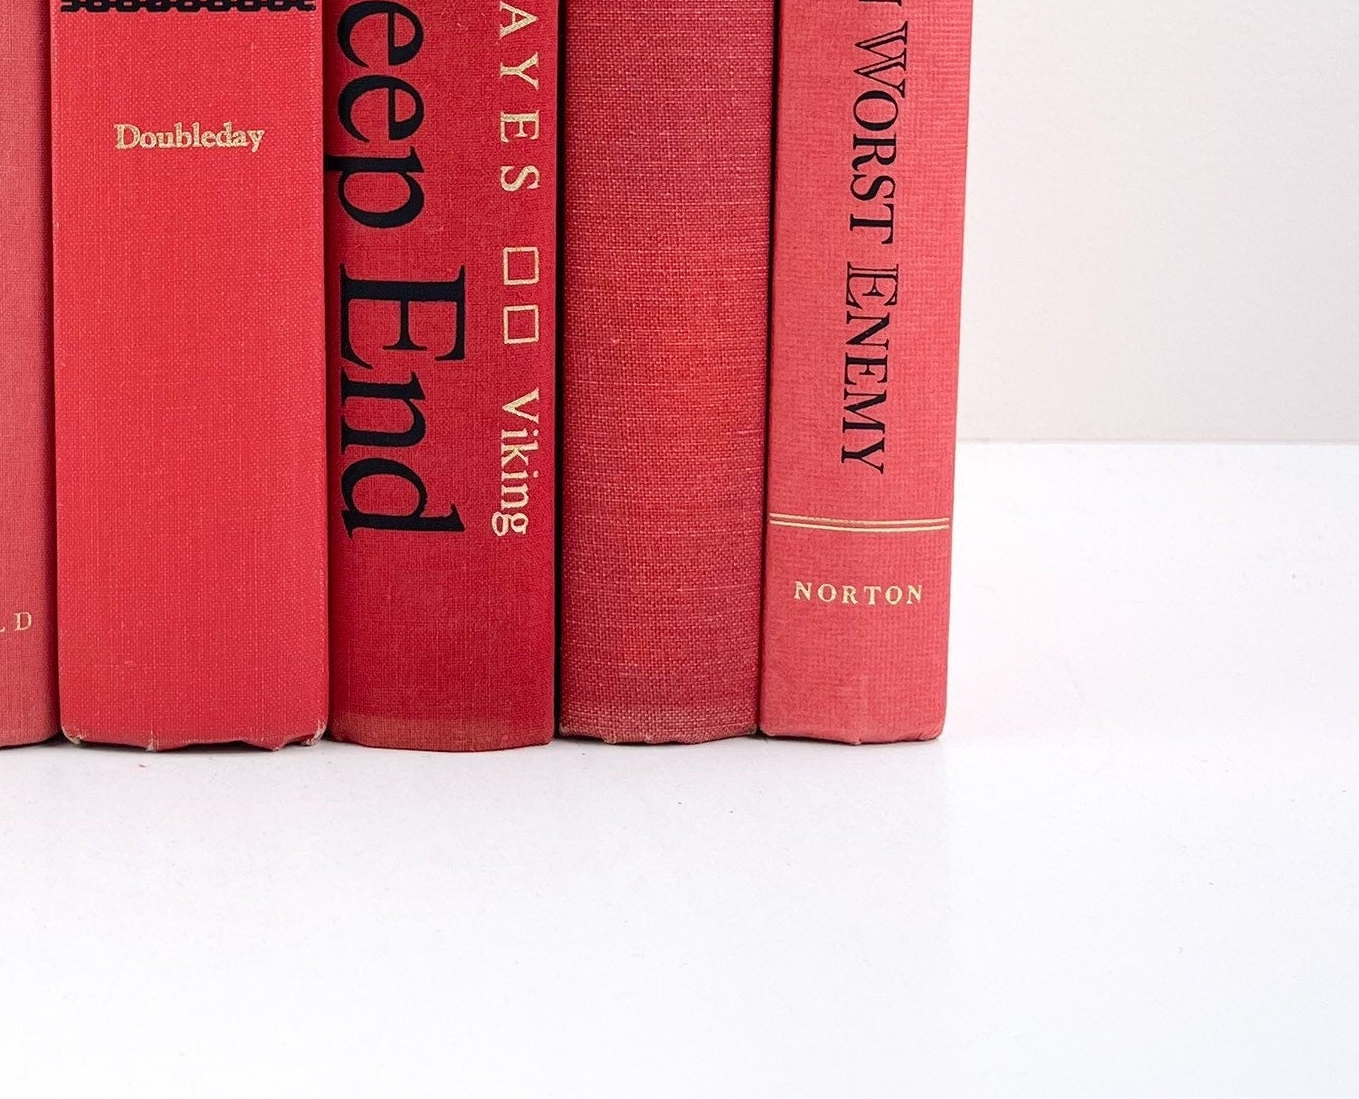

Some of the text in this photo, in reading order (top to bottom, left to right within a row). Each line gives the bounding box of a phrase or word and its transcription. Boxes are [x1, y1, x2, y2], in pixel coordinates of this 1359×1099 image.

[115, 121, 266, 153] Doubleday
[848, 21, 909, 245] WORST
[342, 265, 467, 540] End
[840, 261, 900, 475] ENEMY
[491, 386, 540, 538] Viking
[793, 580, 924, 605] NORTON
